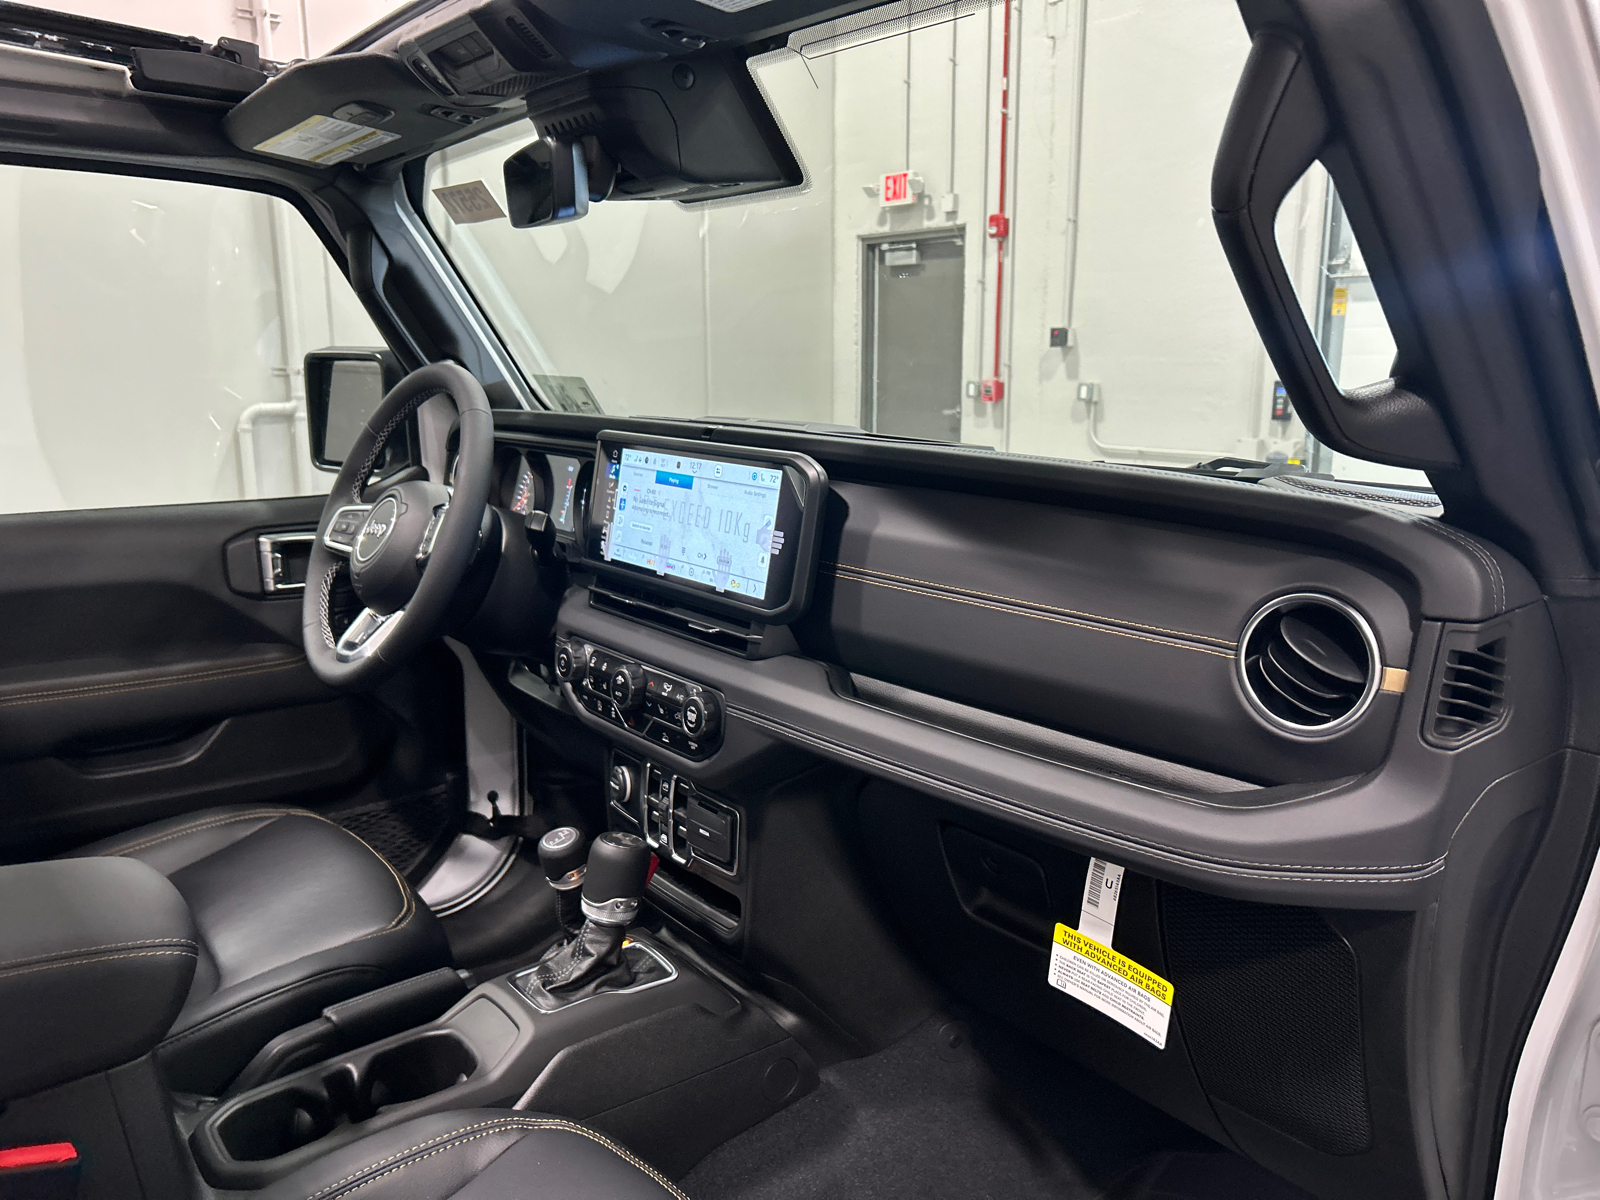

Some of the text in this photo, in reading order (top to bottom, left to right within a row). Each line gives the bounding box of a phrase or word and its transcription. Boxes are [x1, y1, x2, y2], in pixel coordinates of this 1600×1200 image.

[885, 172, 908, 202] EXIT
[1062, 929, 1168, 993] THIS VEHICLE IS EQUIPPED
[1062, 936, 1166, 1000] WITH ADVANCED AIR BAGS
[1072, 954, 1150, 1002] EVEN WITH ADVANCED AIR BAGS
